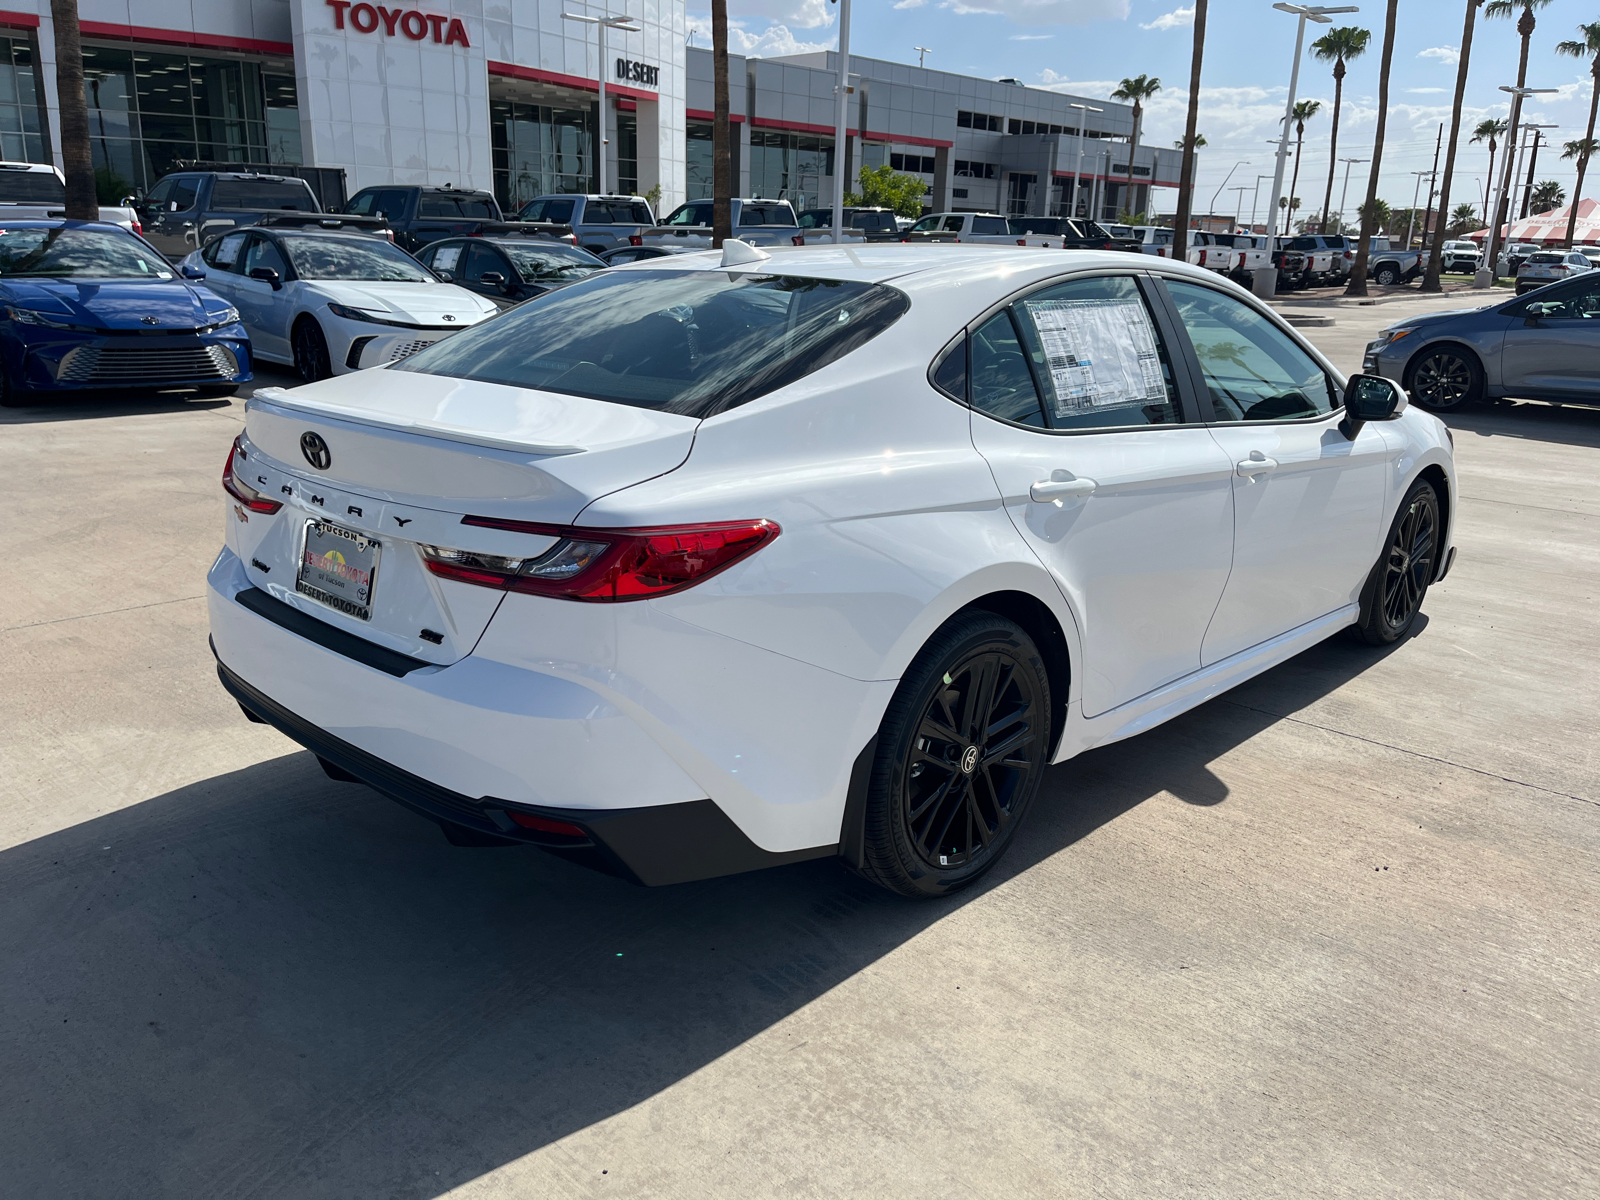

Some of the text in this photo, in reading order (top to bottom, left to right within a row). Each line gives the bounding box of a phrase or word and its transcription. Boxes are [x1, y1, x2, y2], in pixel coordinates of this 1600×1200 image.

[326, 0, 471, 48] TOYOTA
[616, 58, 660, 87] DESERT
[257, 475, 413, 528] CAMRY
[321, 522, 358, 542] TUCSON
[304, 550, 369, 587] DESERT TOYOTA
[318, 572, 346, 589] of Tucson
[297, 581, 363, 618] DESERT TOYOTA
[1034, 662, 1051, 718] KINERGY
[891, 782, 916, 873] HANKOOK
